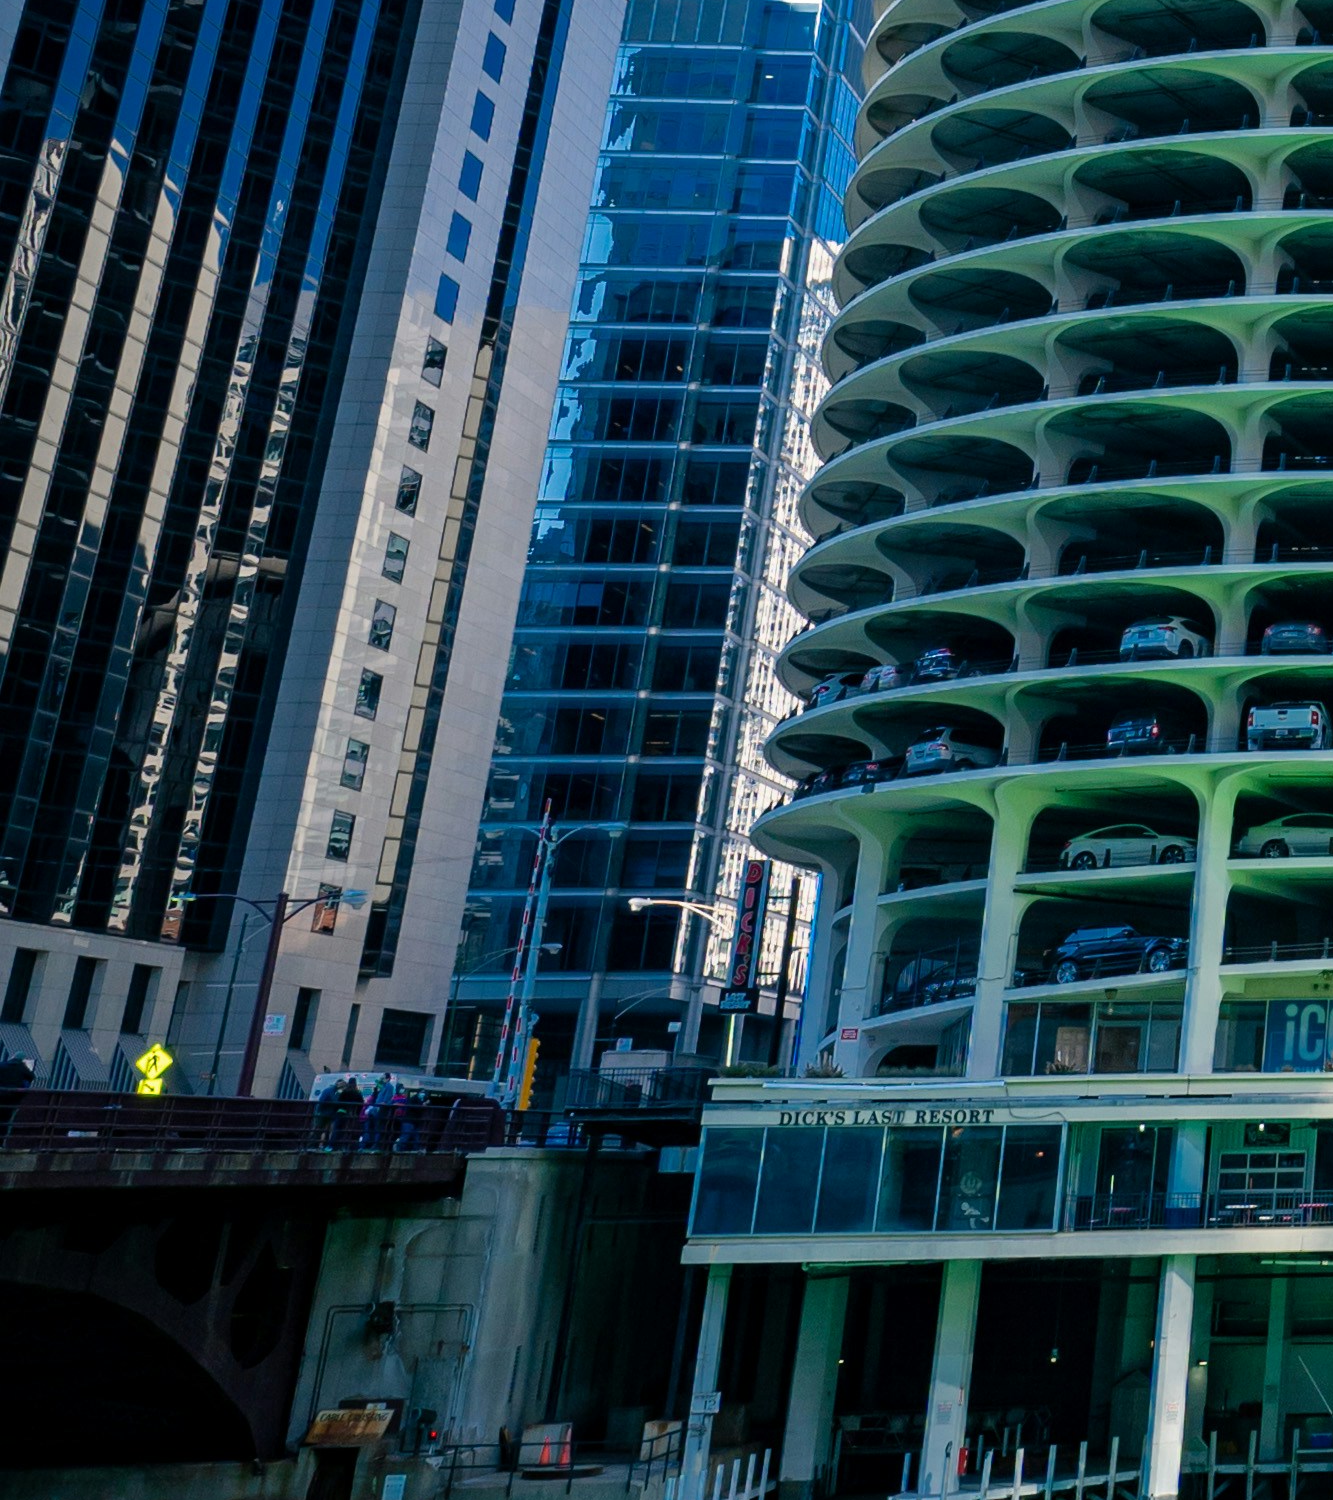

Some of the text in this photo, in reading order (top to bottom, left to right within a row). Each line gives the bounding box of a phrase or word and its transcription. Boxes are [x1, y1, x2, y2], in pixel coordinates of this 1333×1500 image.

[733, 862, 763, 986] DICK'S
[779, 1109, 995, 1126] DICK'S LAST RESORT
